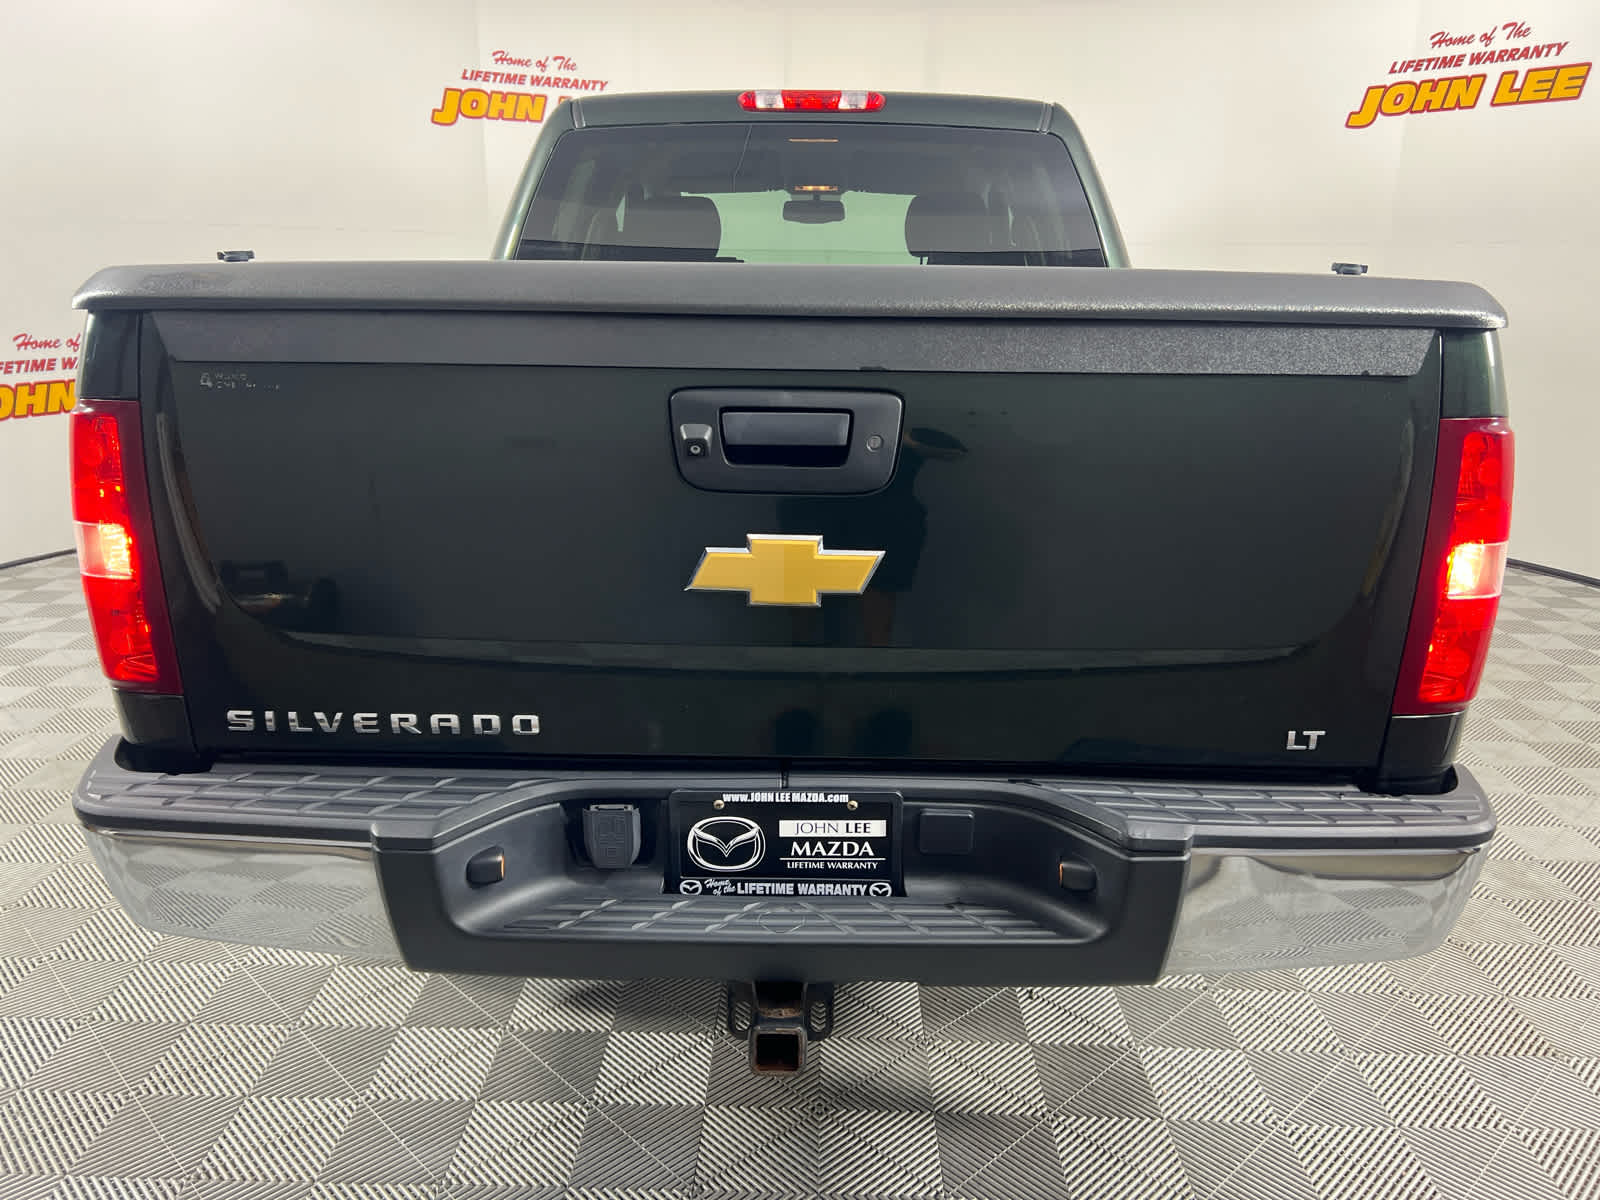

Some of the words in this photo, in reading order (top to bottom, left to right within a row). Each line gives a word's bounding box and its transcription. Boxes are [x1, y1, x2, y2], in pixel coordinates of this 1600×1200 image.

[1429, 31, 1475, 49] Home
[1479, 25, 1497, 46] of
[1502, 21, 1531, 40] The
[492, 50, 532, 67] Home
[535, 56, 549, 72] of
[553, 56, 577, 71] The
[1388, 53, 1466, 74] LIFETIME
[1468, 41, 1569, 66] WARRANTY
[461, 69, 527, 85] LIFETIME
[530, 75, 608, 91] WARRANTY
[1345, 73, 1487, 129] JOHN
[1490, 62, 1592, 107] LEE
[431, 88, 547, 126] JOHN
[12, 333, 60, 351] Home
[65, 332, 80, 352] of
[226, 709, 541, 735] SILVERADO
[1286, 730, 1326, 750] LT
[775, 793, 791, 803] LEE
[791, 793, 849, 803] MAZDA.com
[795, 822, 839, 835] JOHN
[845, 822, 871, 834] LEE
[790, 841, 874, 857] MAZDA
[787, 861, 825, 869] LIFETIME
[827, 862, 878, 870] WARRANTY
[737, 882, 794, 895] LIFETIME
[797, 884, 868, 896] WARRANTY
